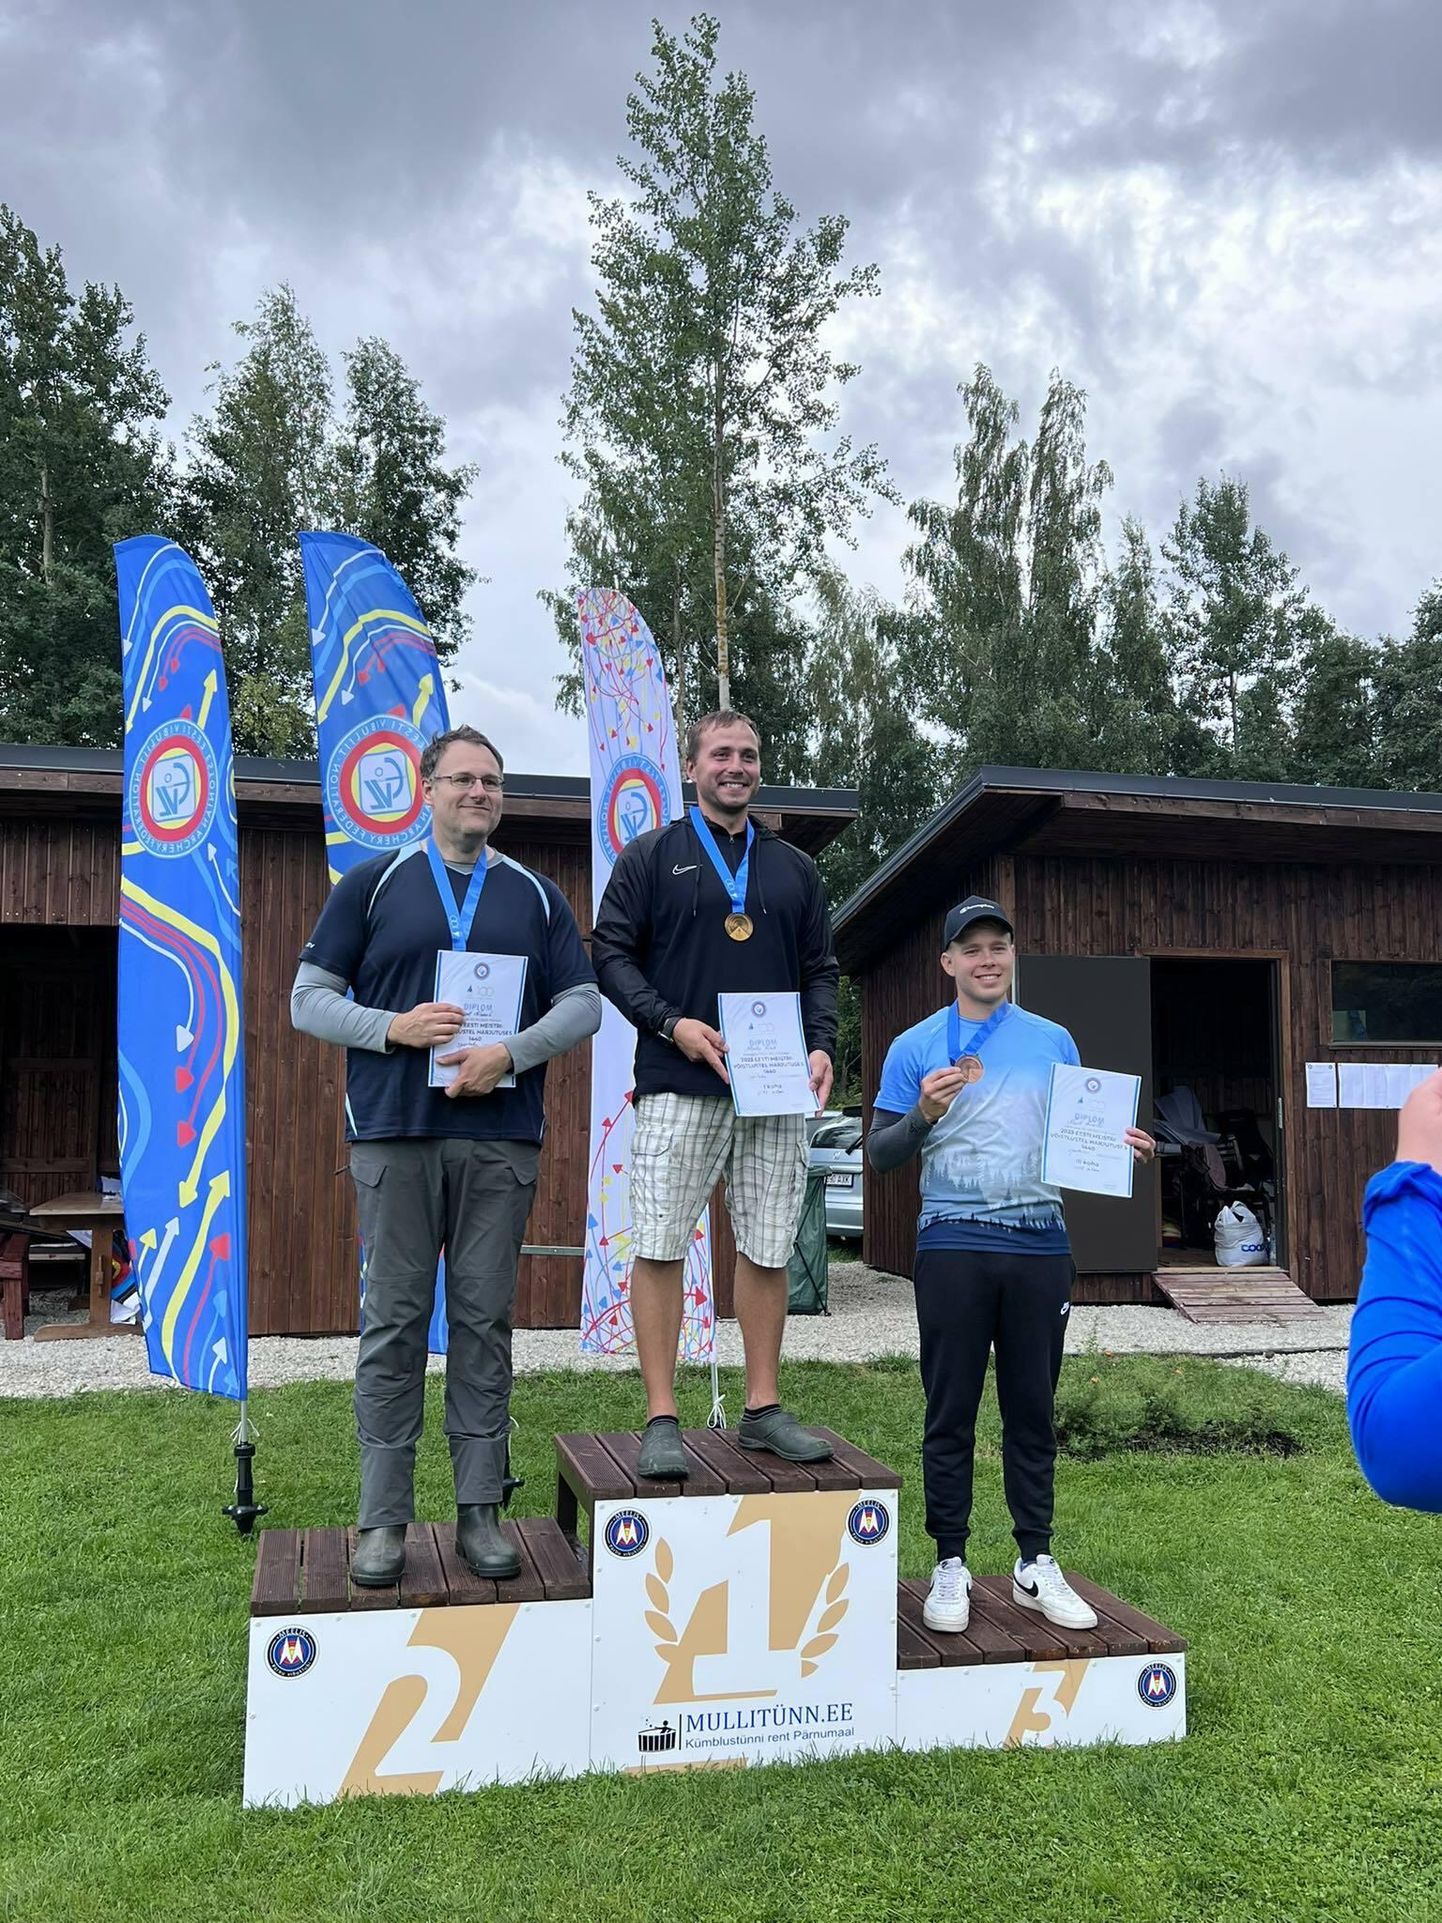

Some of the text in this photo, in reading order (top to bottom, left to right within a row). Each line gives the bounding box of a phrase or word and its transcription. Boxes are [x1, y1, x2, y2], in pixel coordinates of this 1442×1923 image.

[463, 1002, 493, 1012] DIPLOM
[749, 1039, 778, 1047] DIPLOM
[687, 1703, 853, 1733] MULLITÜNN.EE
[686, 1727, 855, 1749] Kümblustünni rent Pärnumaal
